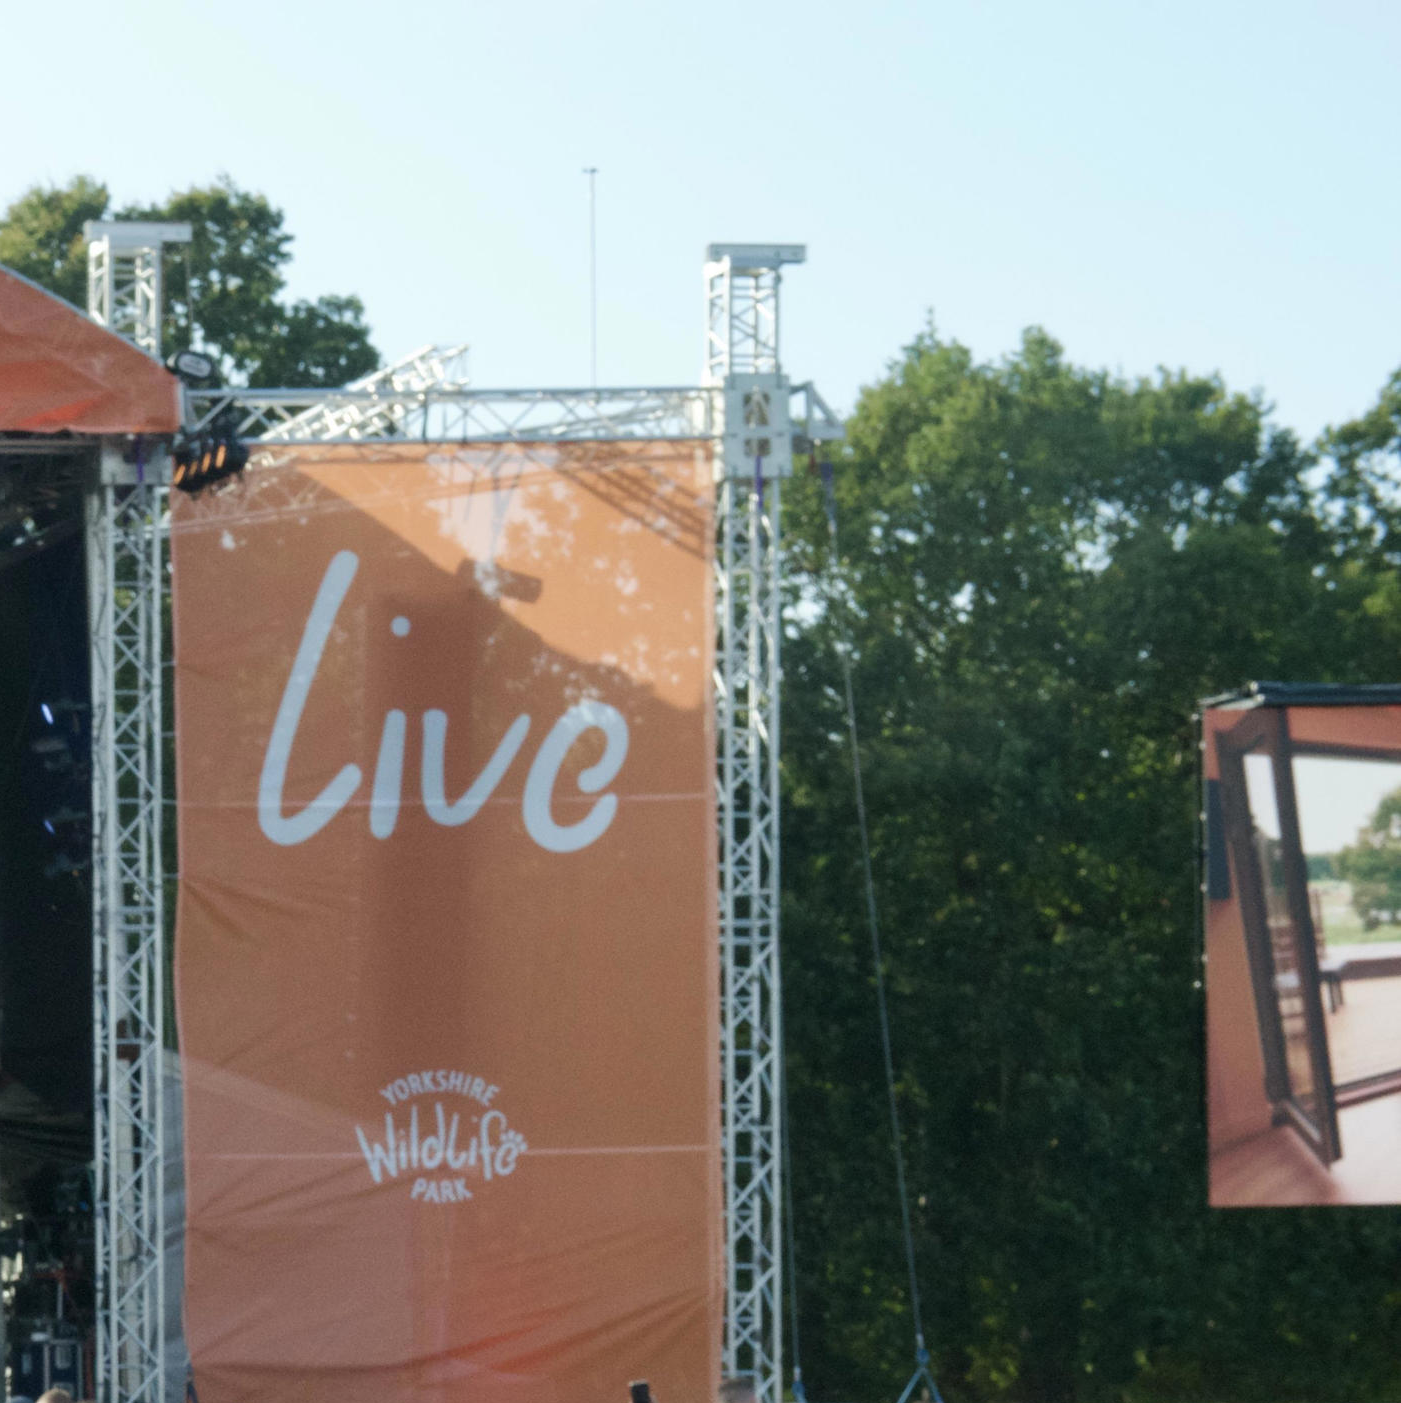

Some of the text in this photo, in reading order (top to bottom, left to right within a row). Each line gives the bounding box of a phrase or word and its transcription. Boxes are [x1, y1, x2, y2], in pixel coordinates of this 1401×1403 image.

[258, 549, 629, 853] Live
[379, 1069, 501, 1107] YORKSHIRE
[409, 1177, 474, 1203] PARK
